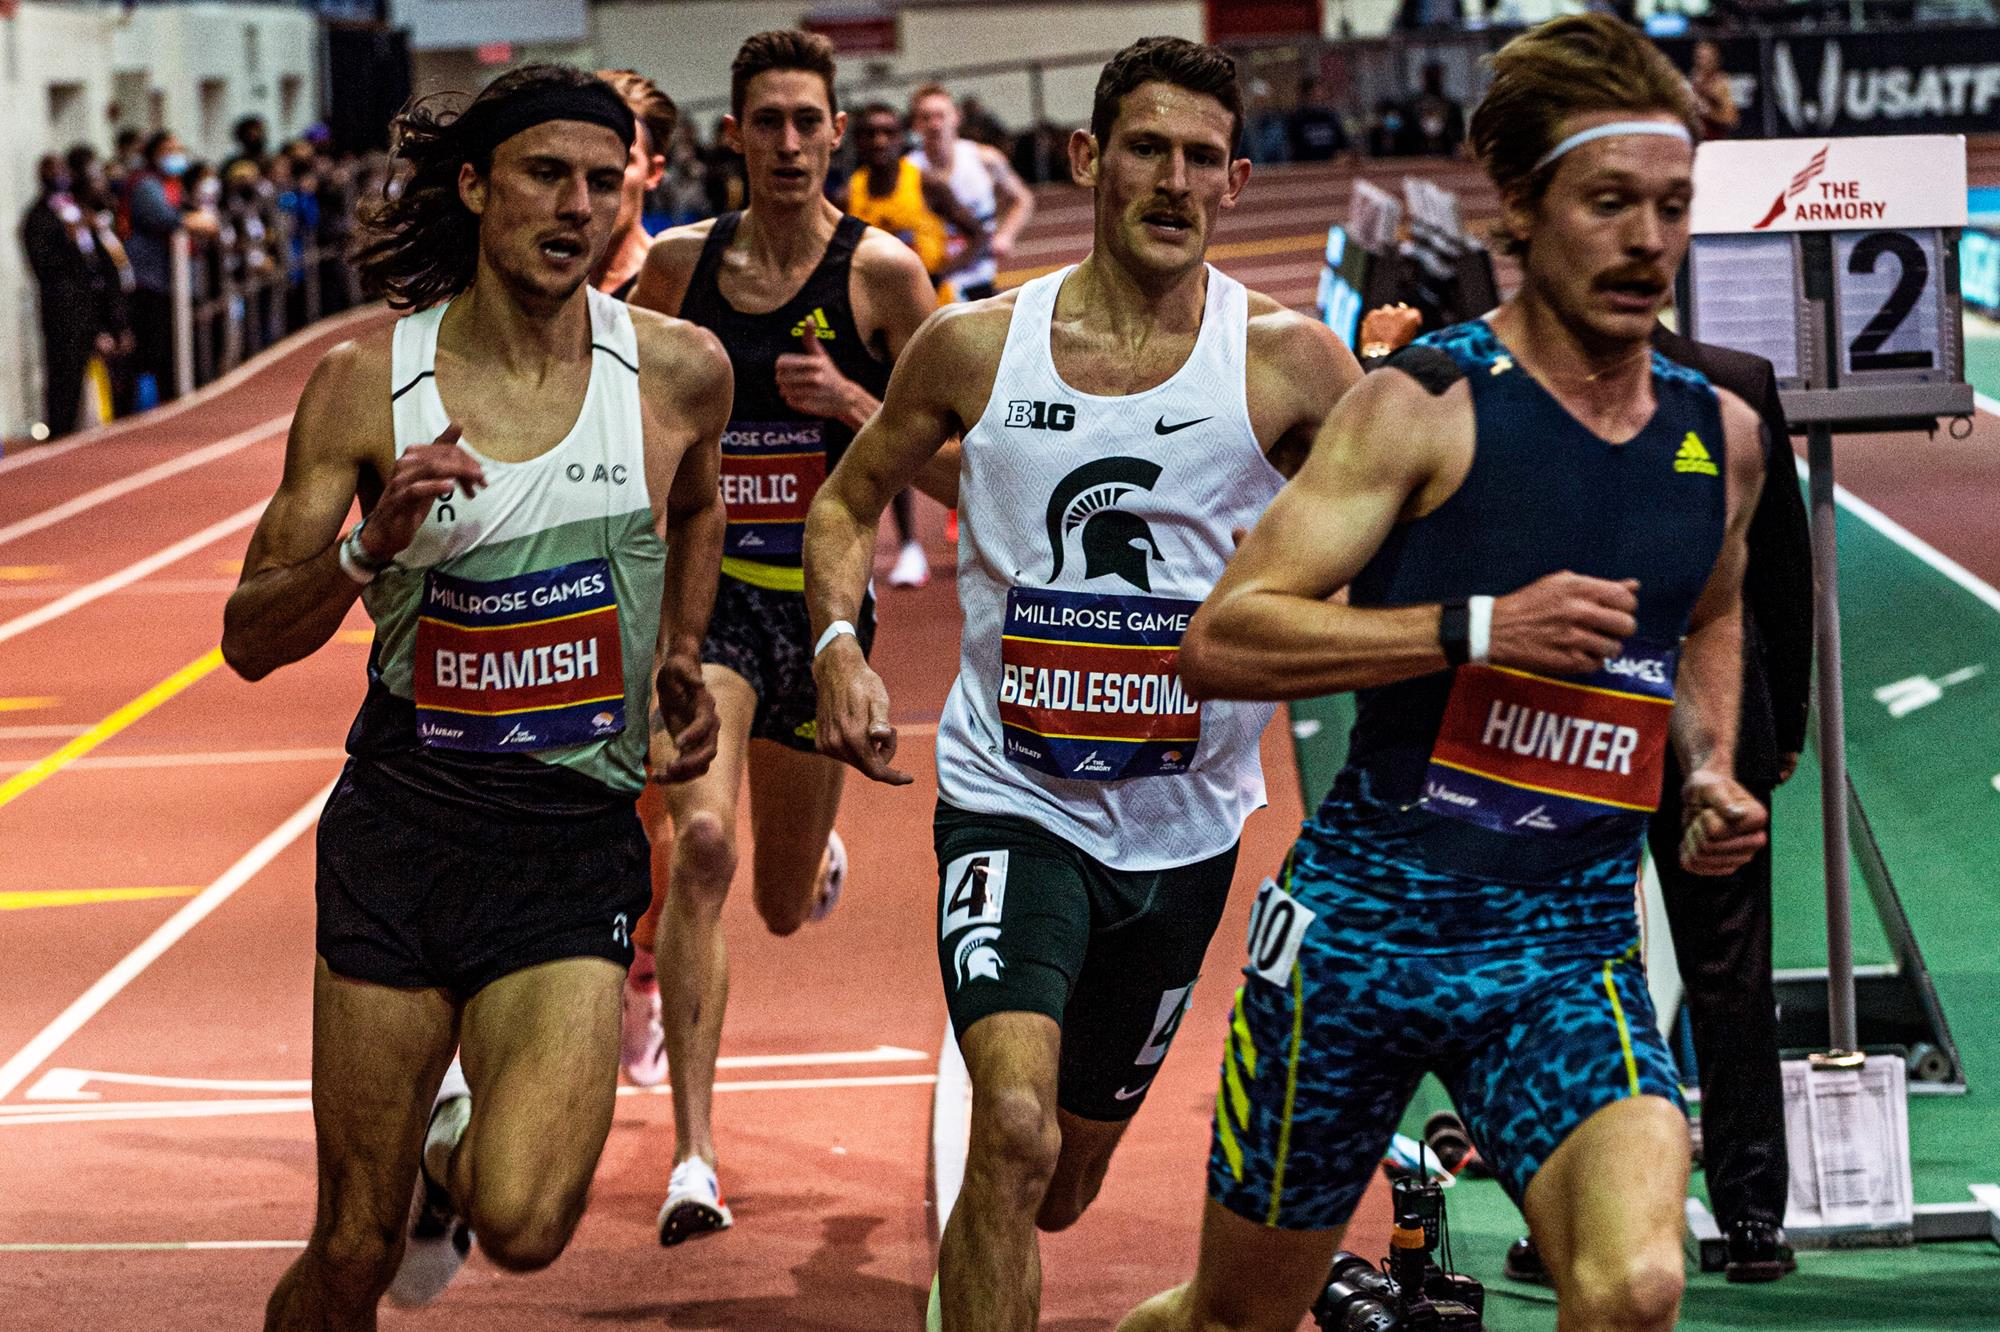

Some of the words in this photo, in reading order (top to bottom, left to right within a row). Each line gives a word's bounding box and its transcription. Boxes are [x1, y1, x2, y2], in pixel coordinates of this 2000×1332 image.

[1795, 201, 1886, 220] ARMORY
[1819, 181, 1859, 199] THE
[1848, 232, 1933, 372] 2
[763, 429, 821, 446] GAMES
[719, 474, 798, 504] ERLIC
[430, 584, 527, 615] MILLROSE
[532, 573, 605, 608] GAMES
[1014, 603, 1122, 630] MILLROSE
[1127, 612, 1192, 631] GAME
[435, 637, 599, 692] BEAMISH
[1482, 700, 1638, 776] HUNTER
[947, 857, 992, 918] 4
[1248, 887, 1295, 971] 10
